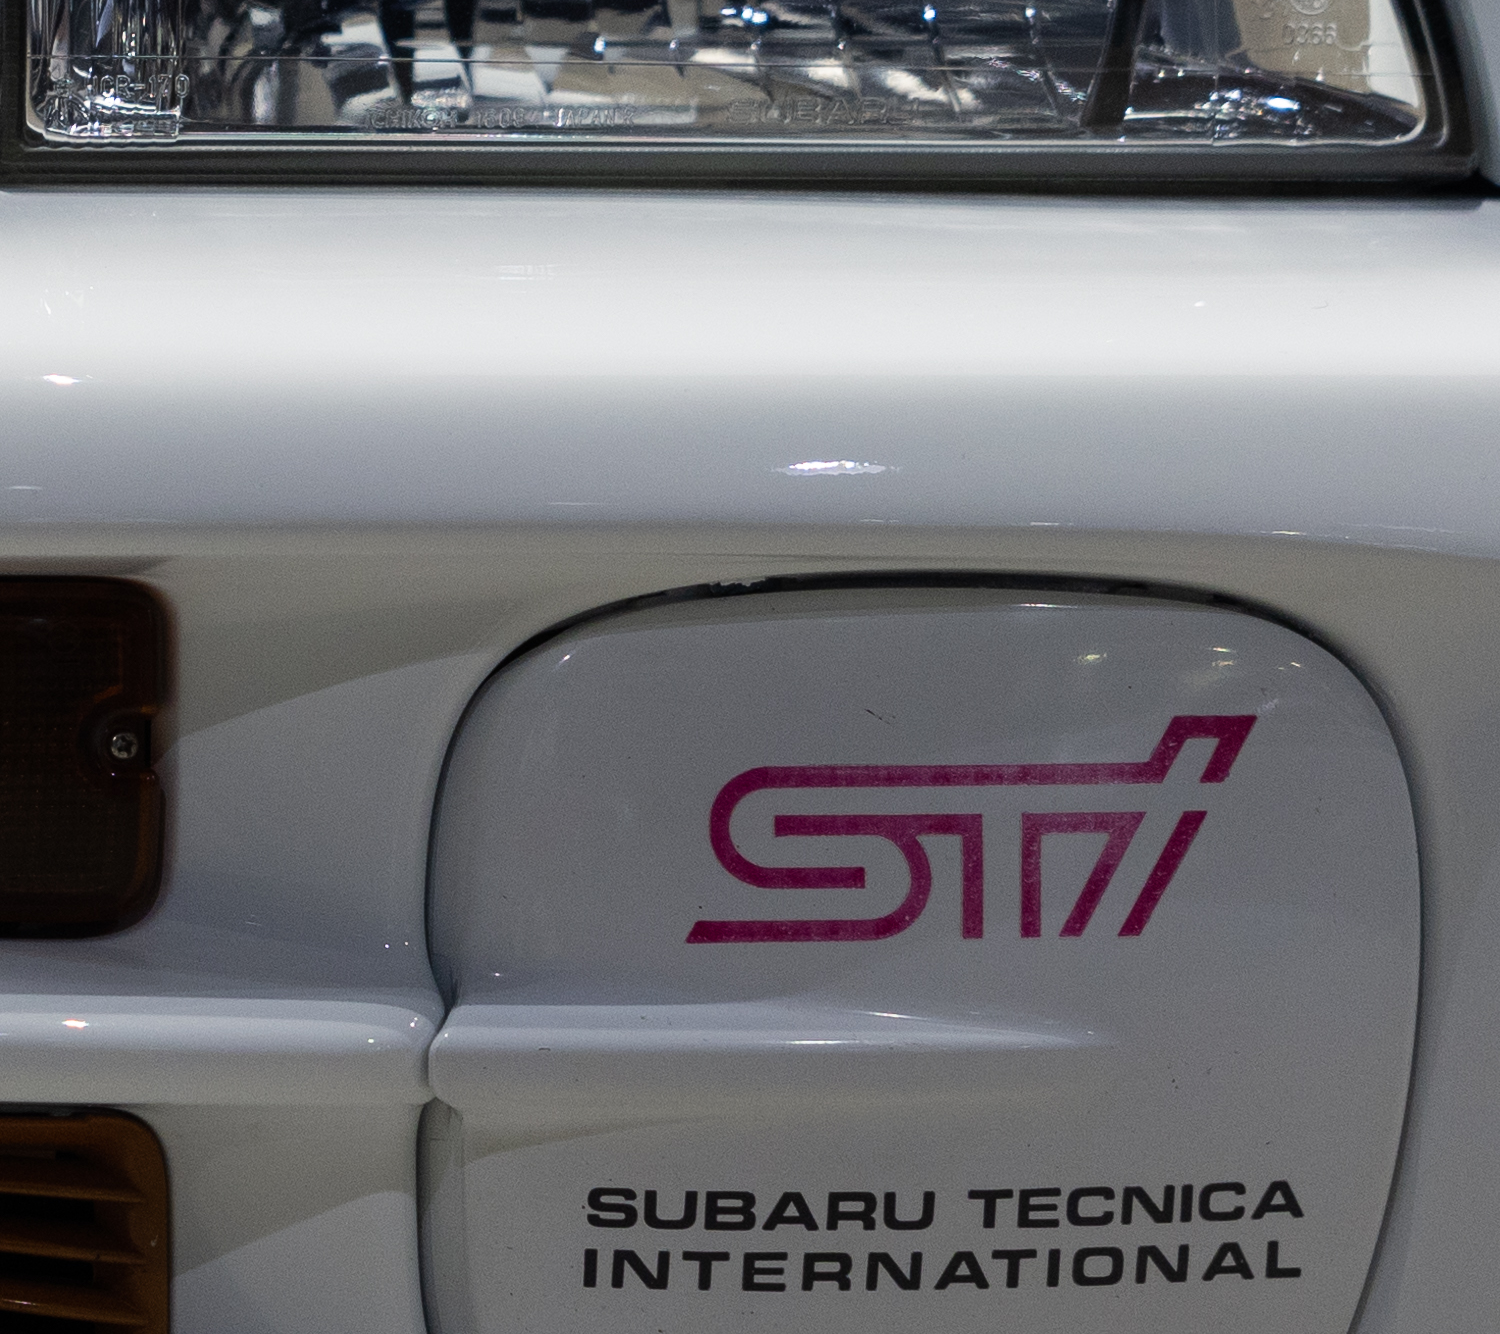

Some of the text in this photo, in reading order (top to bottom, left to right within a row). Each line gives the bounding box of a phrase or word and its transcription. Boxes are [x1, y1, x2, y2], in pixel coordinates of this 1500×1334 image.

[587, 1181, 1303, 1231] SUBARU TECNICA
[583, 1241, 1301, 1292] INTERNATIONAL
